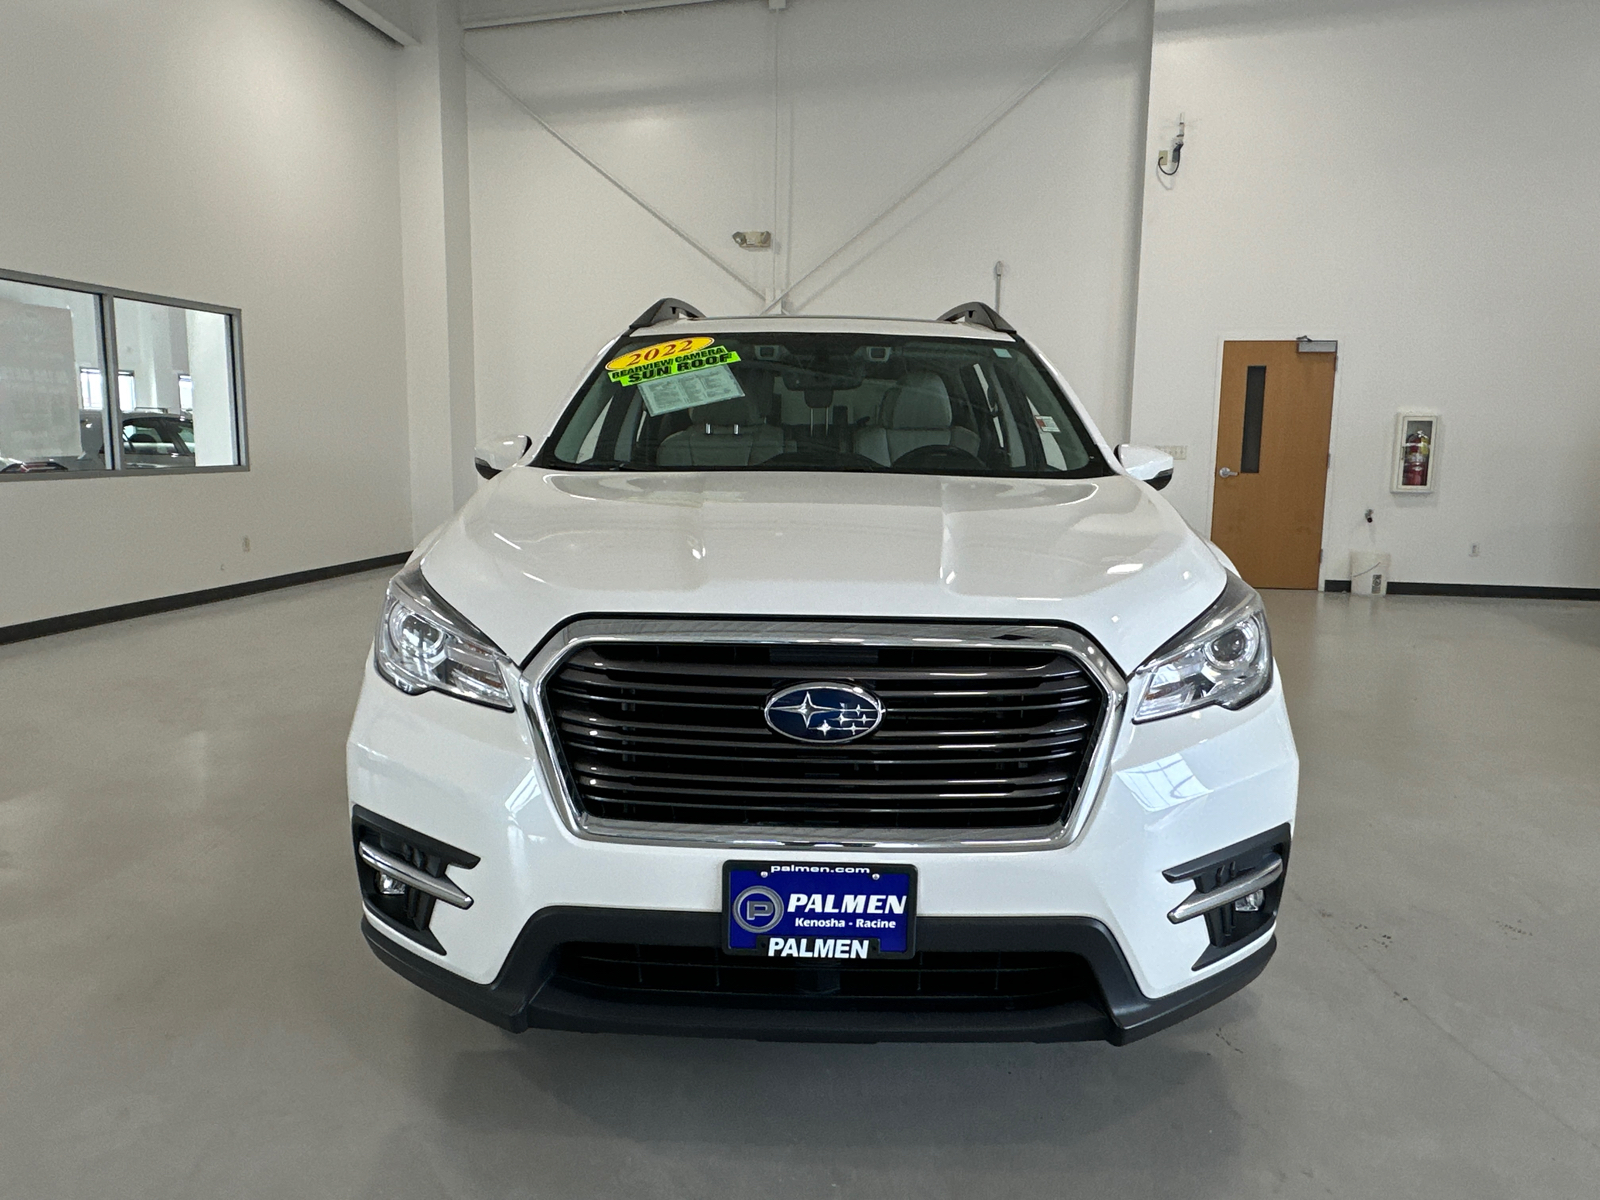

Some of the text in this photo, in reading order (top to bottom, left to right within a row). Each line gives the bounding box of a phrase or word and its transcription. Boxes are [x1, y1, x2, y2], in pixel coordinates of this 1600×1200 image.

[612, 347, 724, 379] REARVIEW CAMERA
[625, 340, 693, 367] 2022
[628, 353, 731, 382] SUN ROOF
[770, 864, 870, 874] palmen.com
[787, 893, 907, 914] PALMEN
[795, 917, 845, 928] Kenosha
[856, 918, 896, 928] Racine
[768, 937, 869, 959] PALMEN
